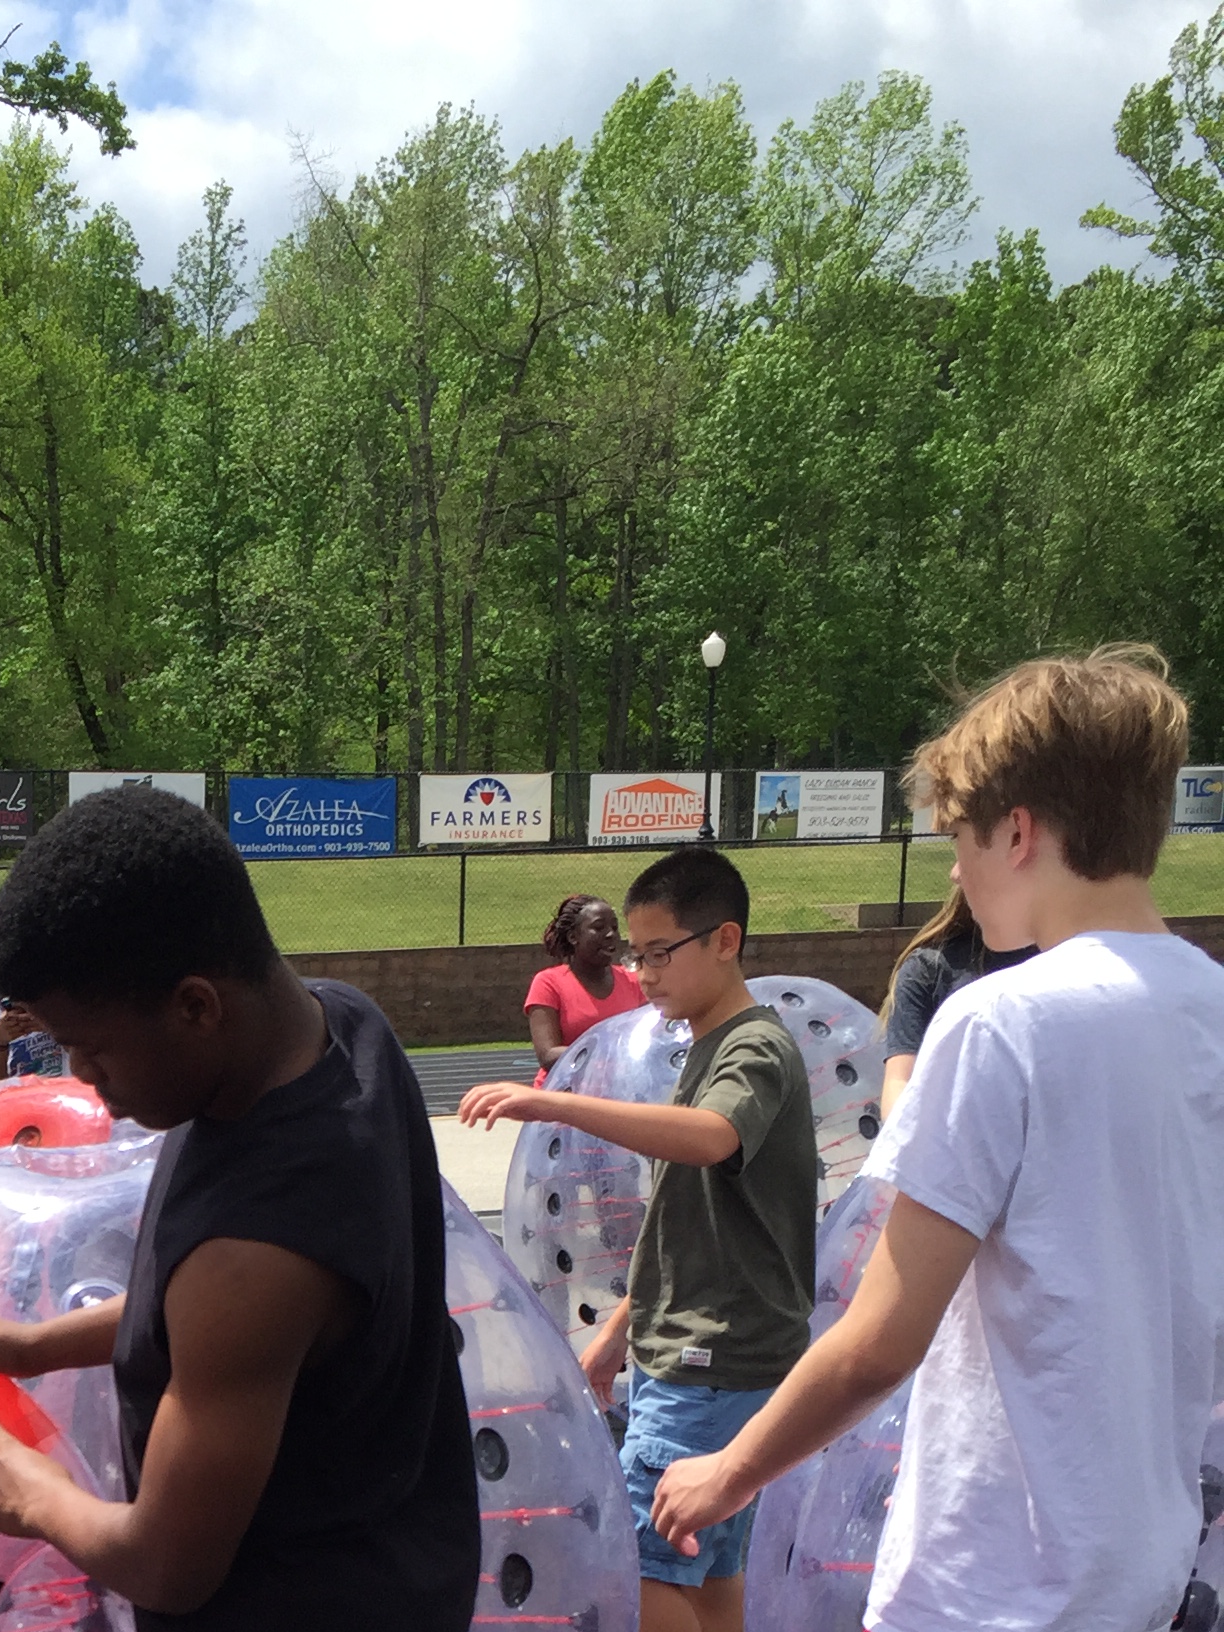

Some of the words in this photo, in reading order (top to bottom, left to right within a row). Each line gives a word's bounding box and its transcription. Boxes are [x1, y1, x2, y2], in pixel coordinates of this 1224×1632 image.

[233, 787, 364, 824] AZALEA
[607, 790, 705, 813] ADVANTAGE
[430, 810, 542, 826] FARMERS
[607, 814, 705, 828] ROOFING
[265, 824, 364, 836] ORTHOPEDICS
[449, 829, 524, 839] INSURANCE
